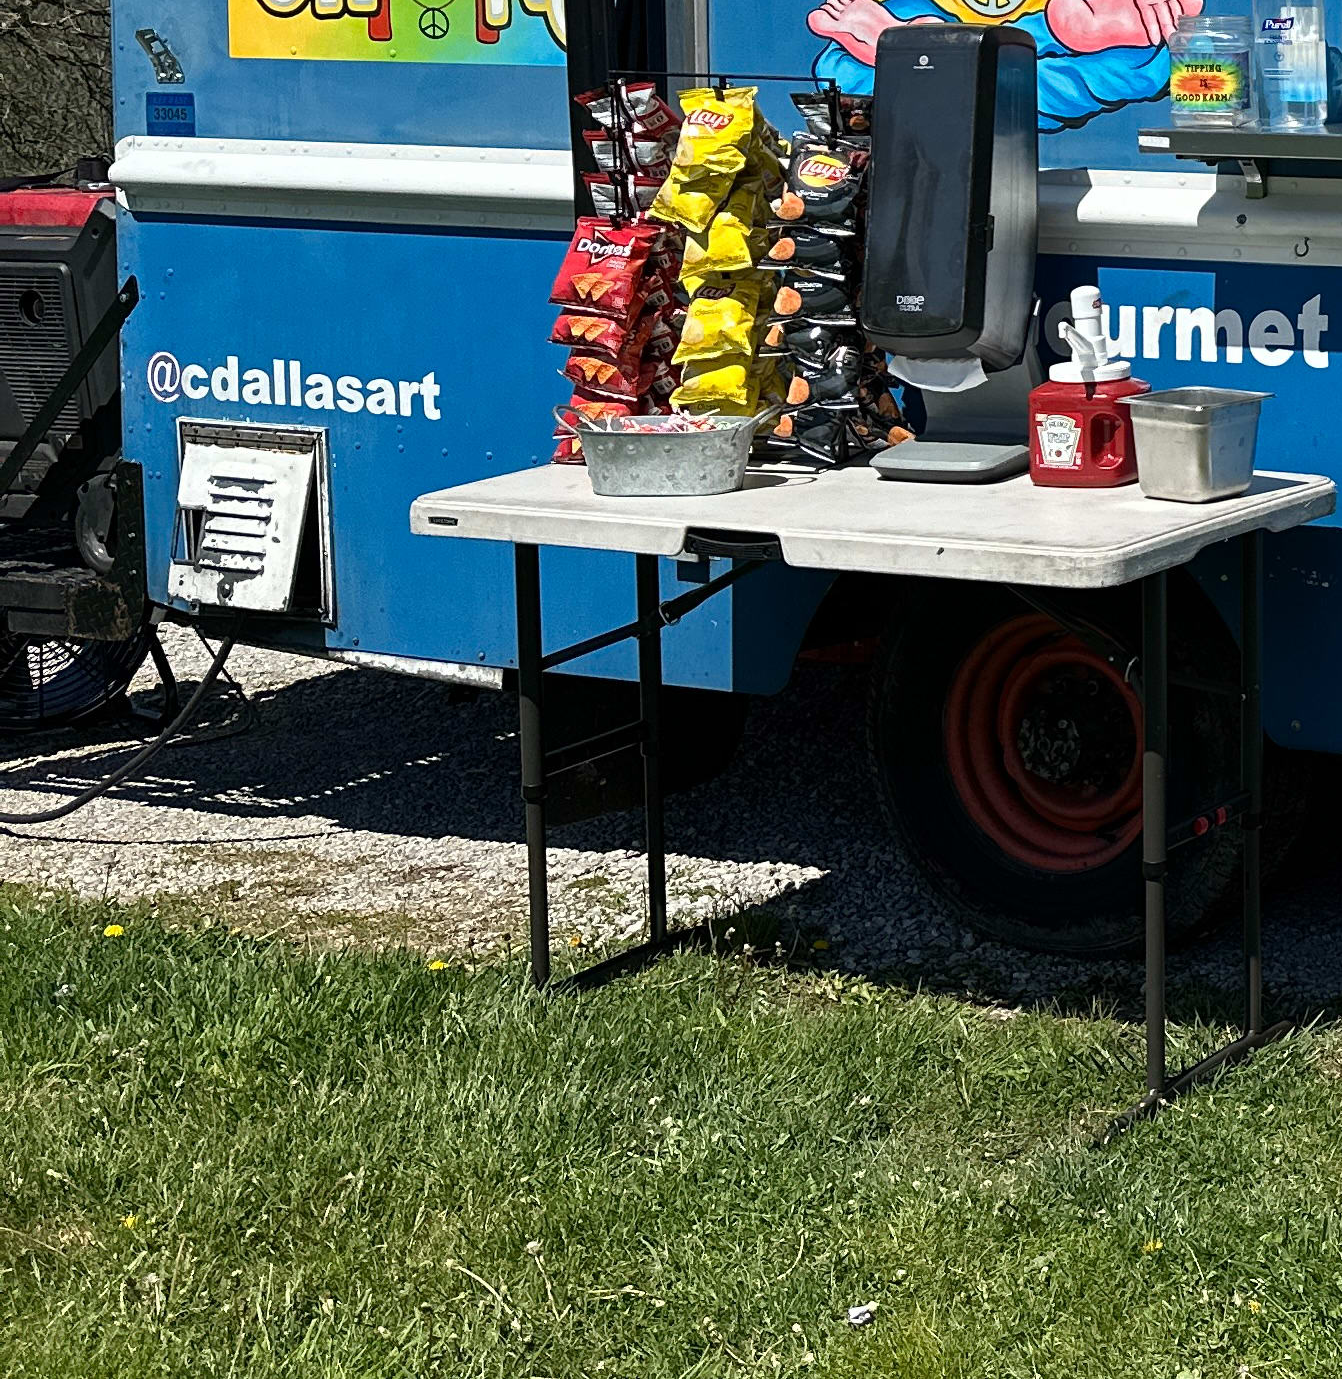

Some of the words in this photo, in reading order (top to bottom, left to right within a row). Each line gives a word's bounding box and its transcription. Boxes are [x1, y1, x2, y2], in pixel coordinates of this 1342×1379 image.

[1185, 64, 1222, 73] TIPPING
[1200, 78, 1208, 88] IS
[1175, 93, 1201, 102] GOOD
[153, 107, 188, 121] 33045
[576, 237, 633, 259] Doritos
[147, 351, 441, 421] @cdallasart
